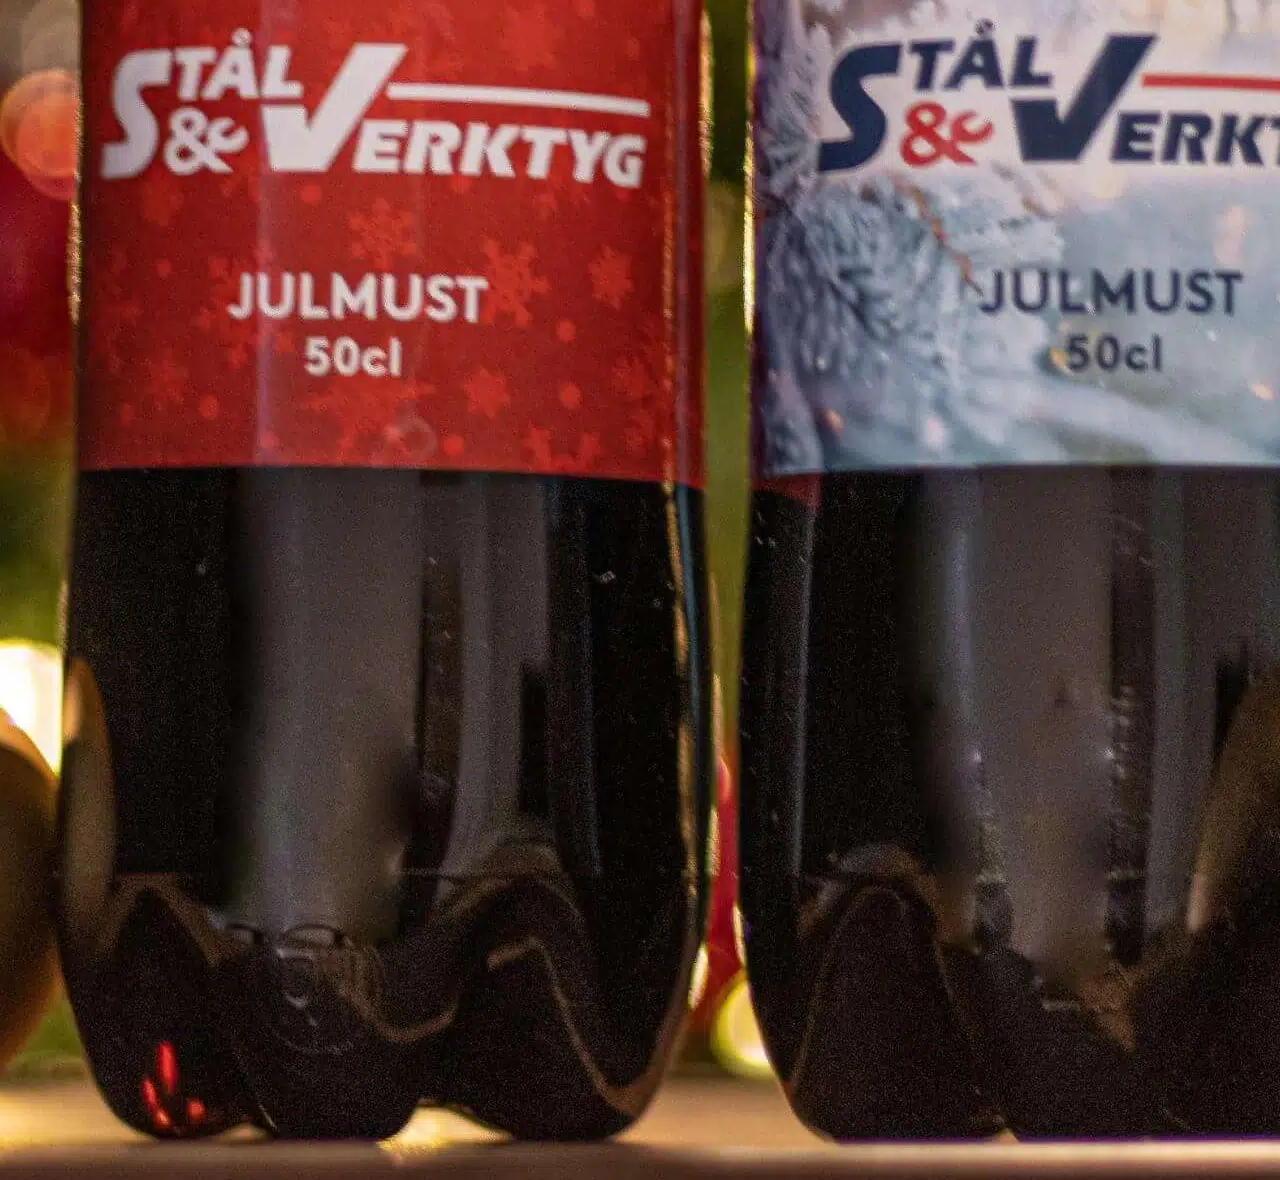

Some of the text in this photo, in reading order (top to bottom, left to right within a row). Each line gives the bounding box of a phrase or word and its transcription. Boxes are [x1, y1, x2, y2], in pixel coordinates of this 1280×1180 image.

[101, 28, 647, 189] STÅL & VERKTYG
[820, 21, 1053, 172] STÅL
[899, 101, 993, 168] &
[227, 272, 489, 323] JULMUST
[979, 269, 1244, 316] JULMUST
[304, 336, 403, 378] 50cl
[1065, 334, 1162, 373] 50cl
